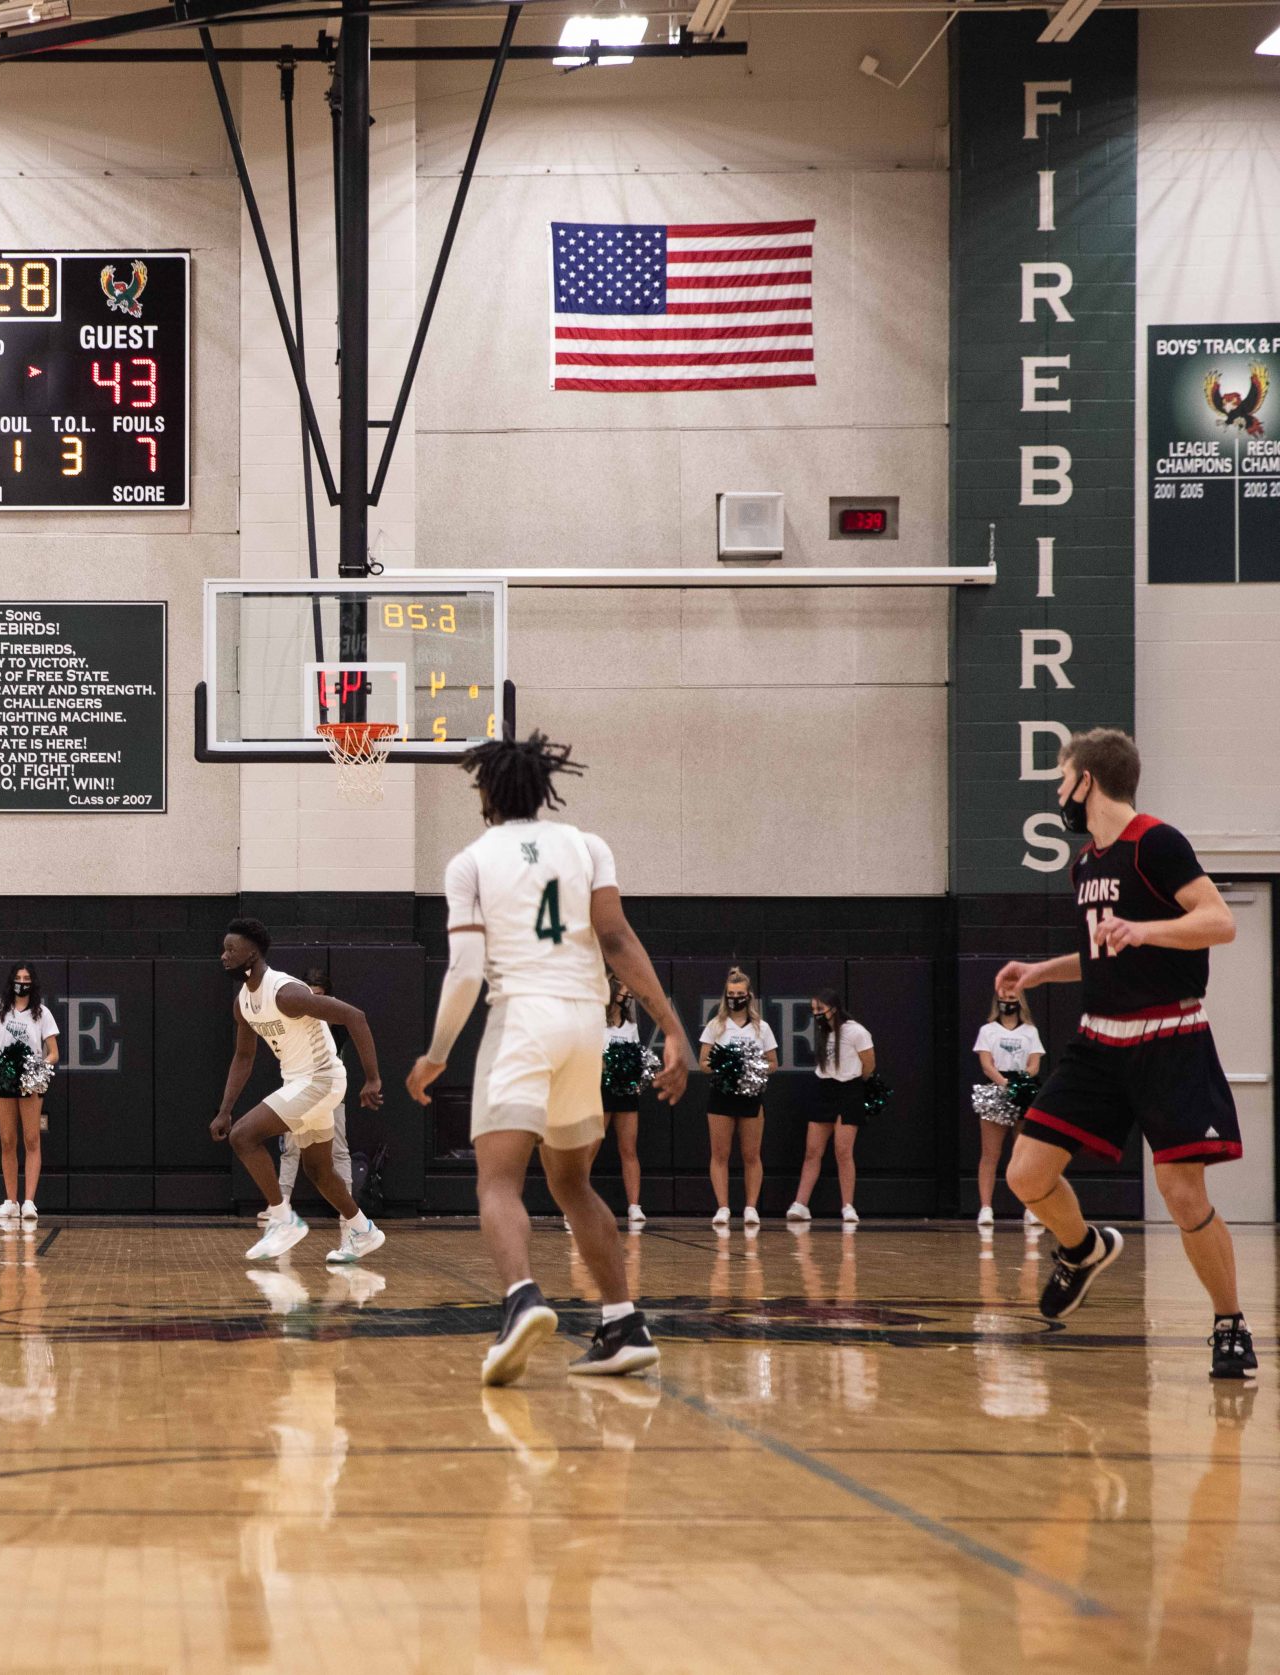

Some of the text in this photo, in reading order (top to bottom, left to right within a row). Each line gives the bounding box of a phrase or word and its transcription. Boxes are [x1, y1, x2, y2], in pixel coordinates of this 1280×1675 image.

[79, 325, 159, 350] GUEST
[1156, 339, 1201, 355] BOYS'
[1203, 338, 1256, 354] TRACK
[1258, 338, 1270, 353] &
[91, 358, 157, 408] 43
[51, 416, 96, 433] T.O.L.
[112, 416, 165, 433] FOULS
[62, 436, 83, 476] 3
[136, 437, 157, 473] 7
[1169, 441, 1220, 457] LEAGUE
[1156, 457, 1233, 474] CHAMPIONS
[112, 486, 165, 503] SCORE
[1154, 484, 1204, 499] 2001 2005
[1243, 482, 1268, 498] 2002
[122, 795, 152, 804] 2007
[1078, 878, 1120, 905] LIONS
[535, 878, 567, 944] 4
